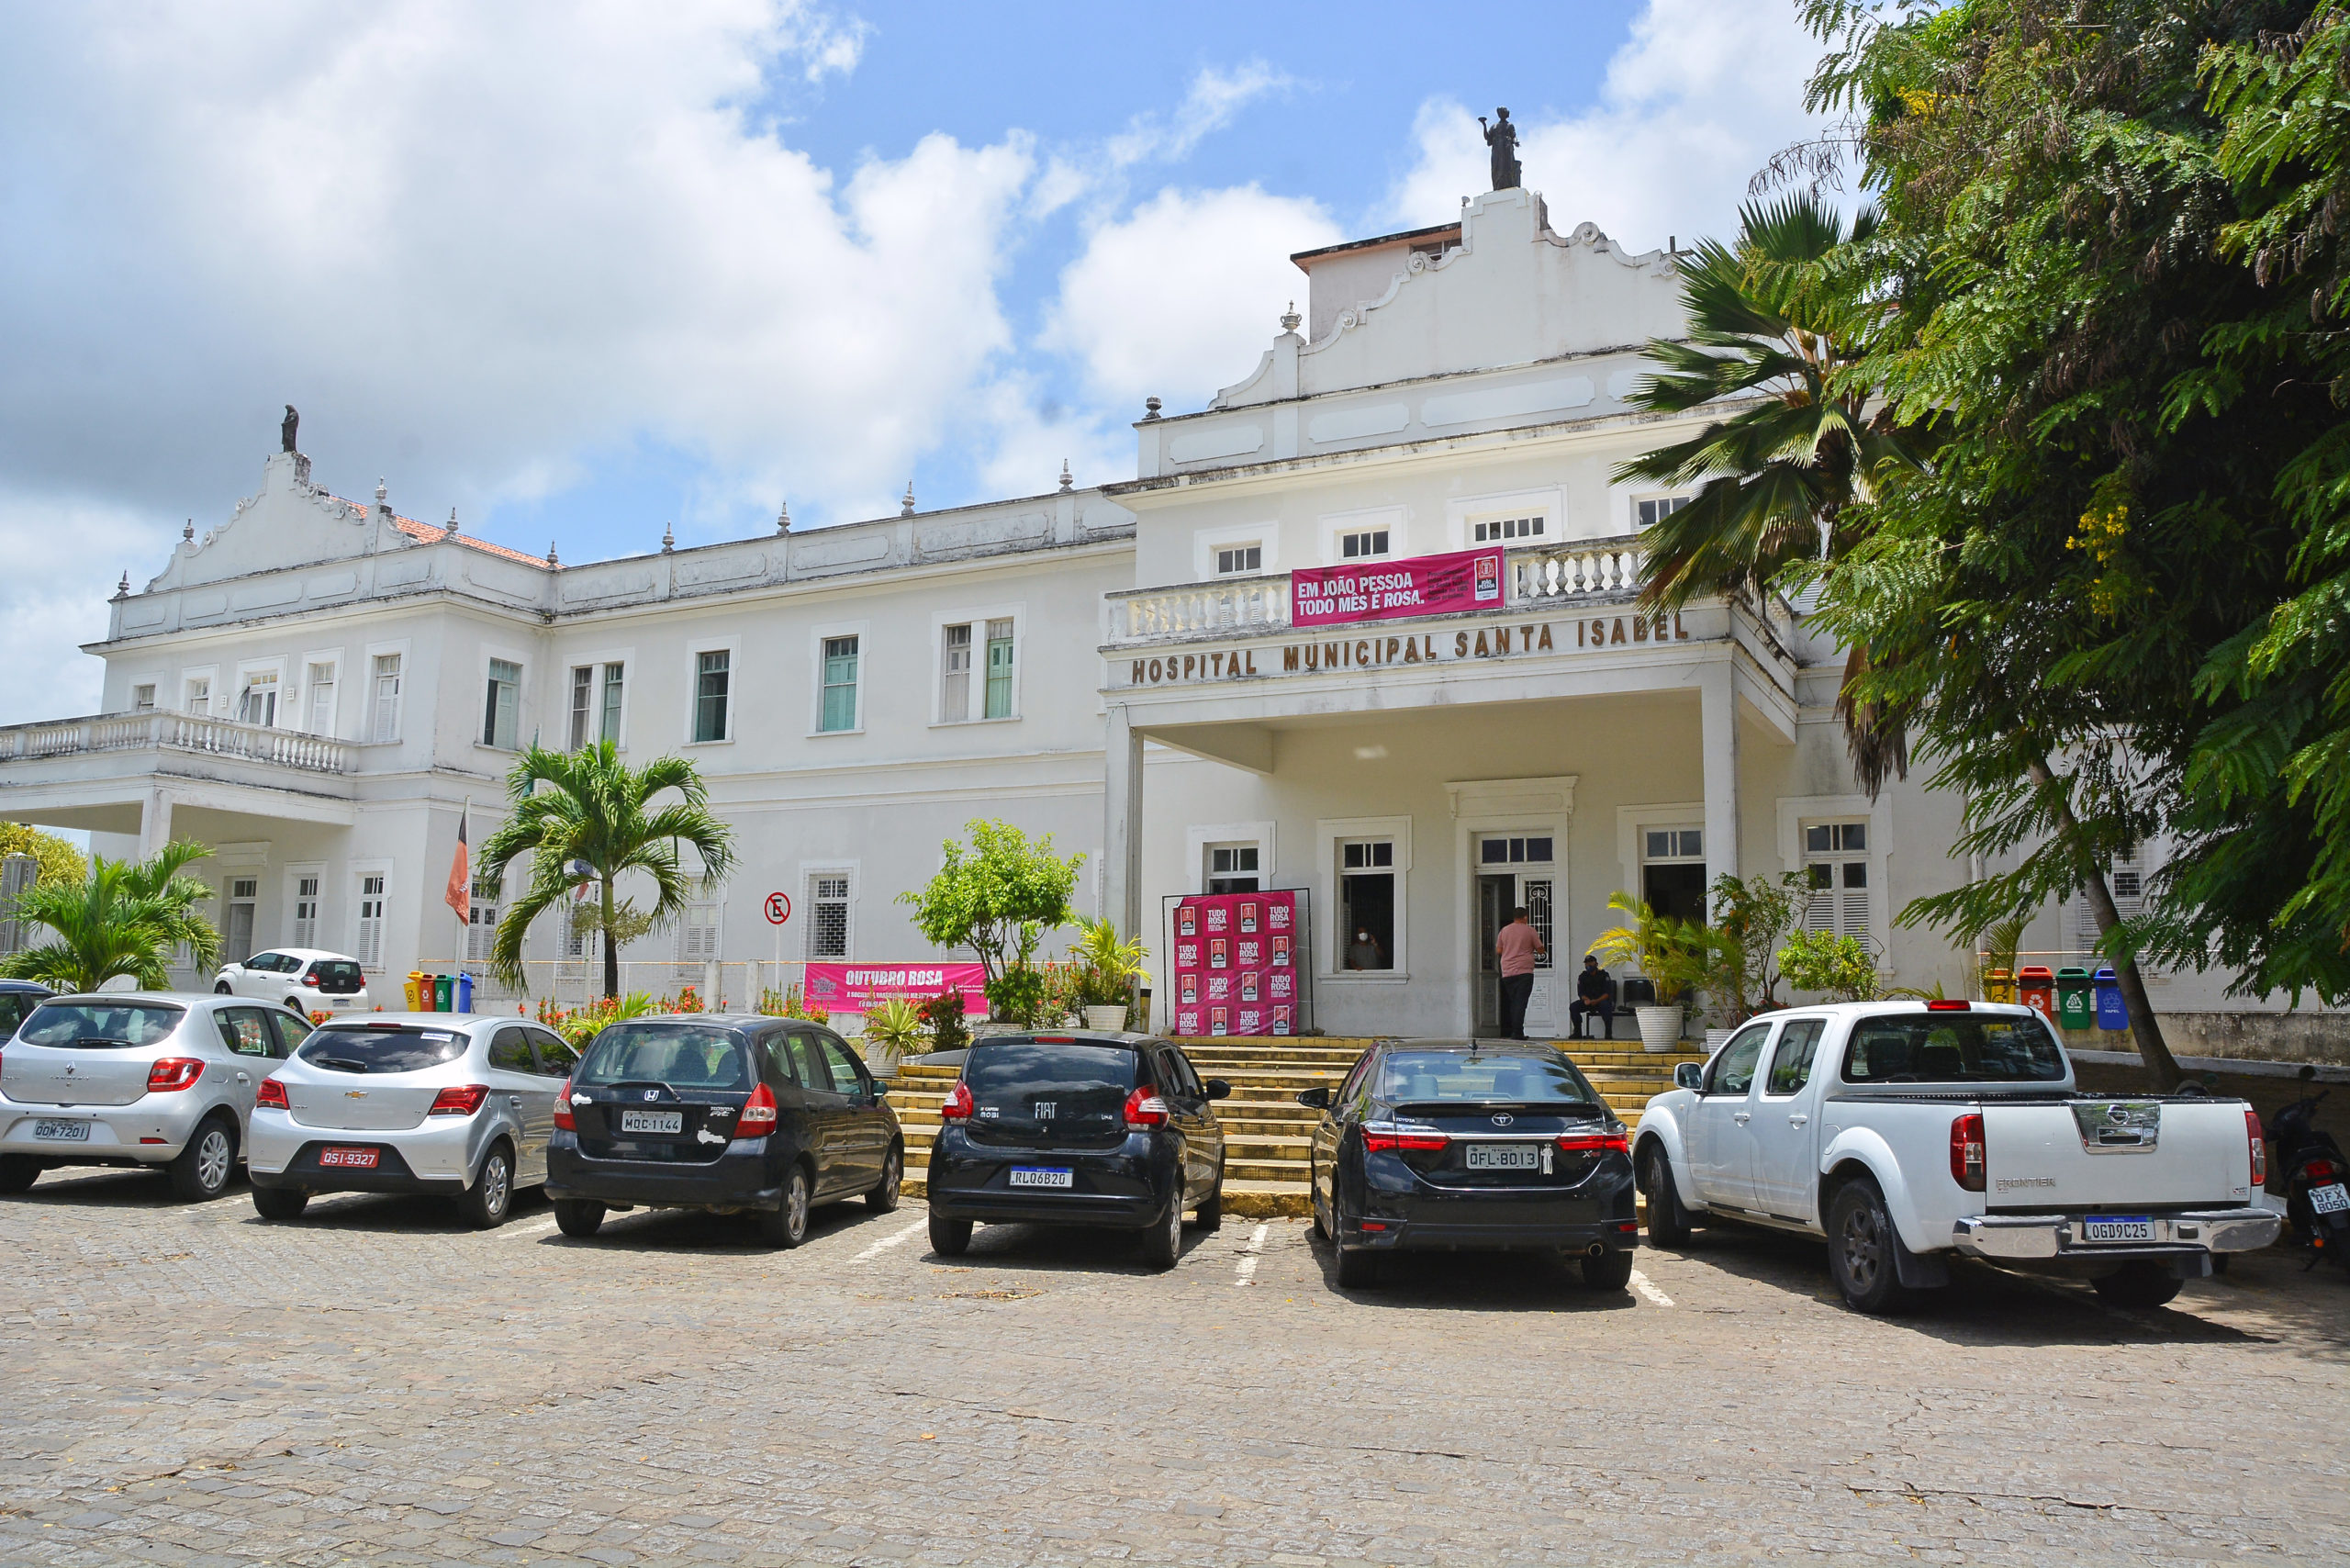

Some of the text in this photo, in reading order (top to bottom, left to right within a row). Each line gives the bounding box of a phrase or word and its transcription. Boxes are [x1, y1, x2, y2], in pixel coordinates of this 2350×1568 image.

[1298, 582, 1318, 599] EM
[1322, 576, 1356, 597] JOÃO
[1359, 572, 1413, 593] PESSOA
[1297, 589, 1425, 616] TODO MÊS É ROSA.
[1132, 613, 1688, 684] HOSPITAL MUNICIPAL SANTA ISABEL
[1207, 909, 1226, 917] TUDO
[1269, 905, 1289, 914] TUDO
[1270, 913, 1289, 922] ROSA
[1178, 945, 1197, 953] TUDO
[1238, 942, 1259, 950] TUDO
[1179, 952, 1197, 960] ROSA
[1239, 949, 1259, 958] ROSA
[845, 970, 944, 986] OUTUBRO ROSA
[1270, 975, 1291, 983] TUDO
[1209, 985, 1228, 993] ROSA
[1270, 982, 1291, 991] ROSA
[1239, 1011, 1259, 1019] TUDO
[1239, 1018, 1259, 1026] ROSA
[1035, 1102, 1057, 1119] FIAT
[1015, 1172, 1065, 1184] RLQ6B20
[1996, 1177, 2056, 1188] FRONTIER
[2318, 1199, 2348, 1212] 8050
[2093, 1224, 2147, 1238] OGD9C25
